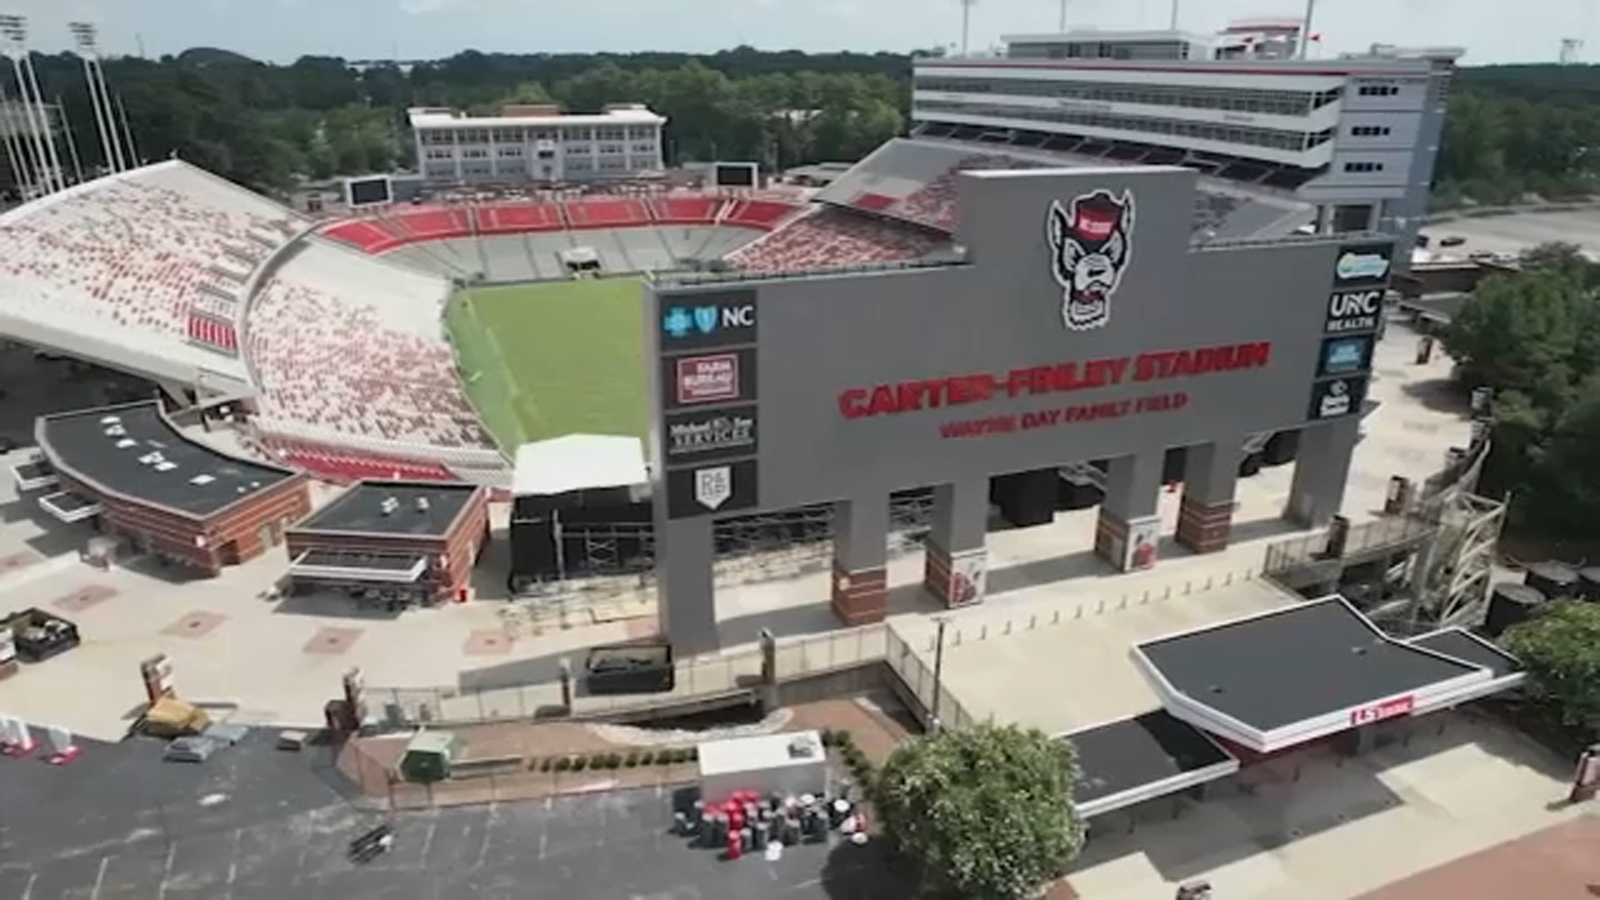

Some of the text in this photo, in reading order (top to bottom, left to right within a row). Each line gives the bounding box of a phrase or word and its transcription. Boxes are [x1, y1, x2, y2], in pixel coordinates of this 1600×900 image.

[1331, 291, 1380, 317] UNC
[722, 306, 754, 328] NC
[1133, 341, 1271, 382] STADIUM
[1021, 408, 1061, 430] DAY
